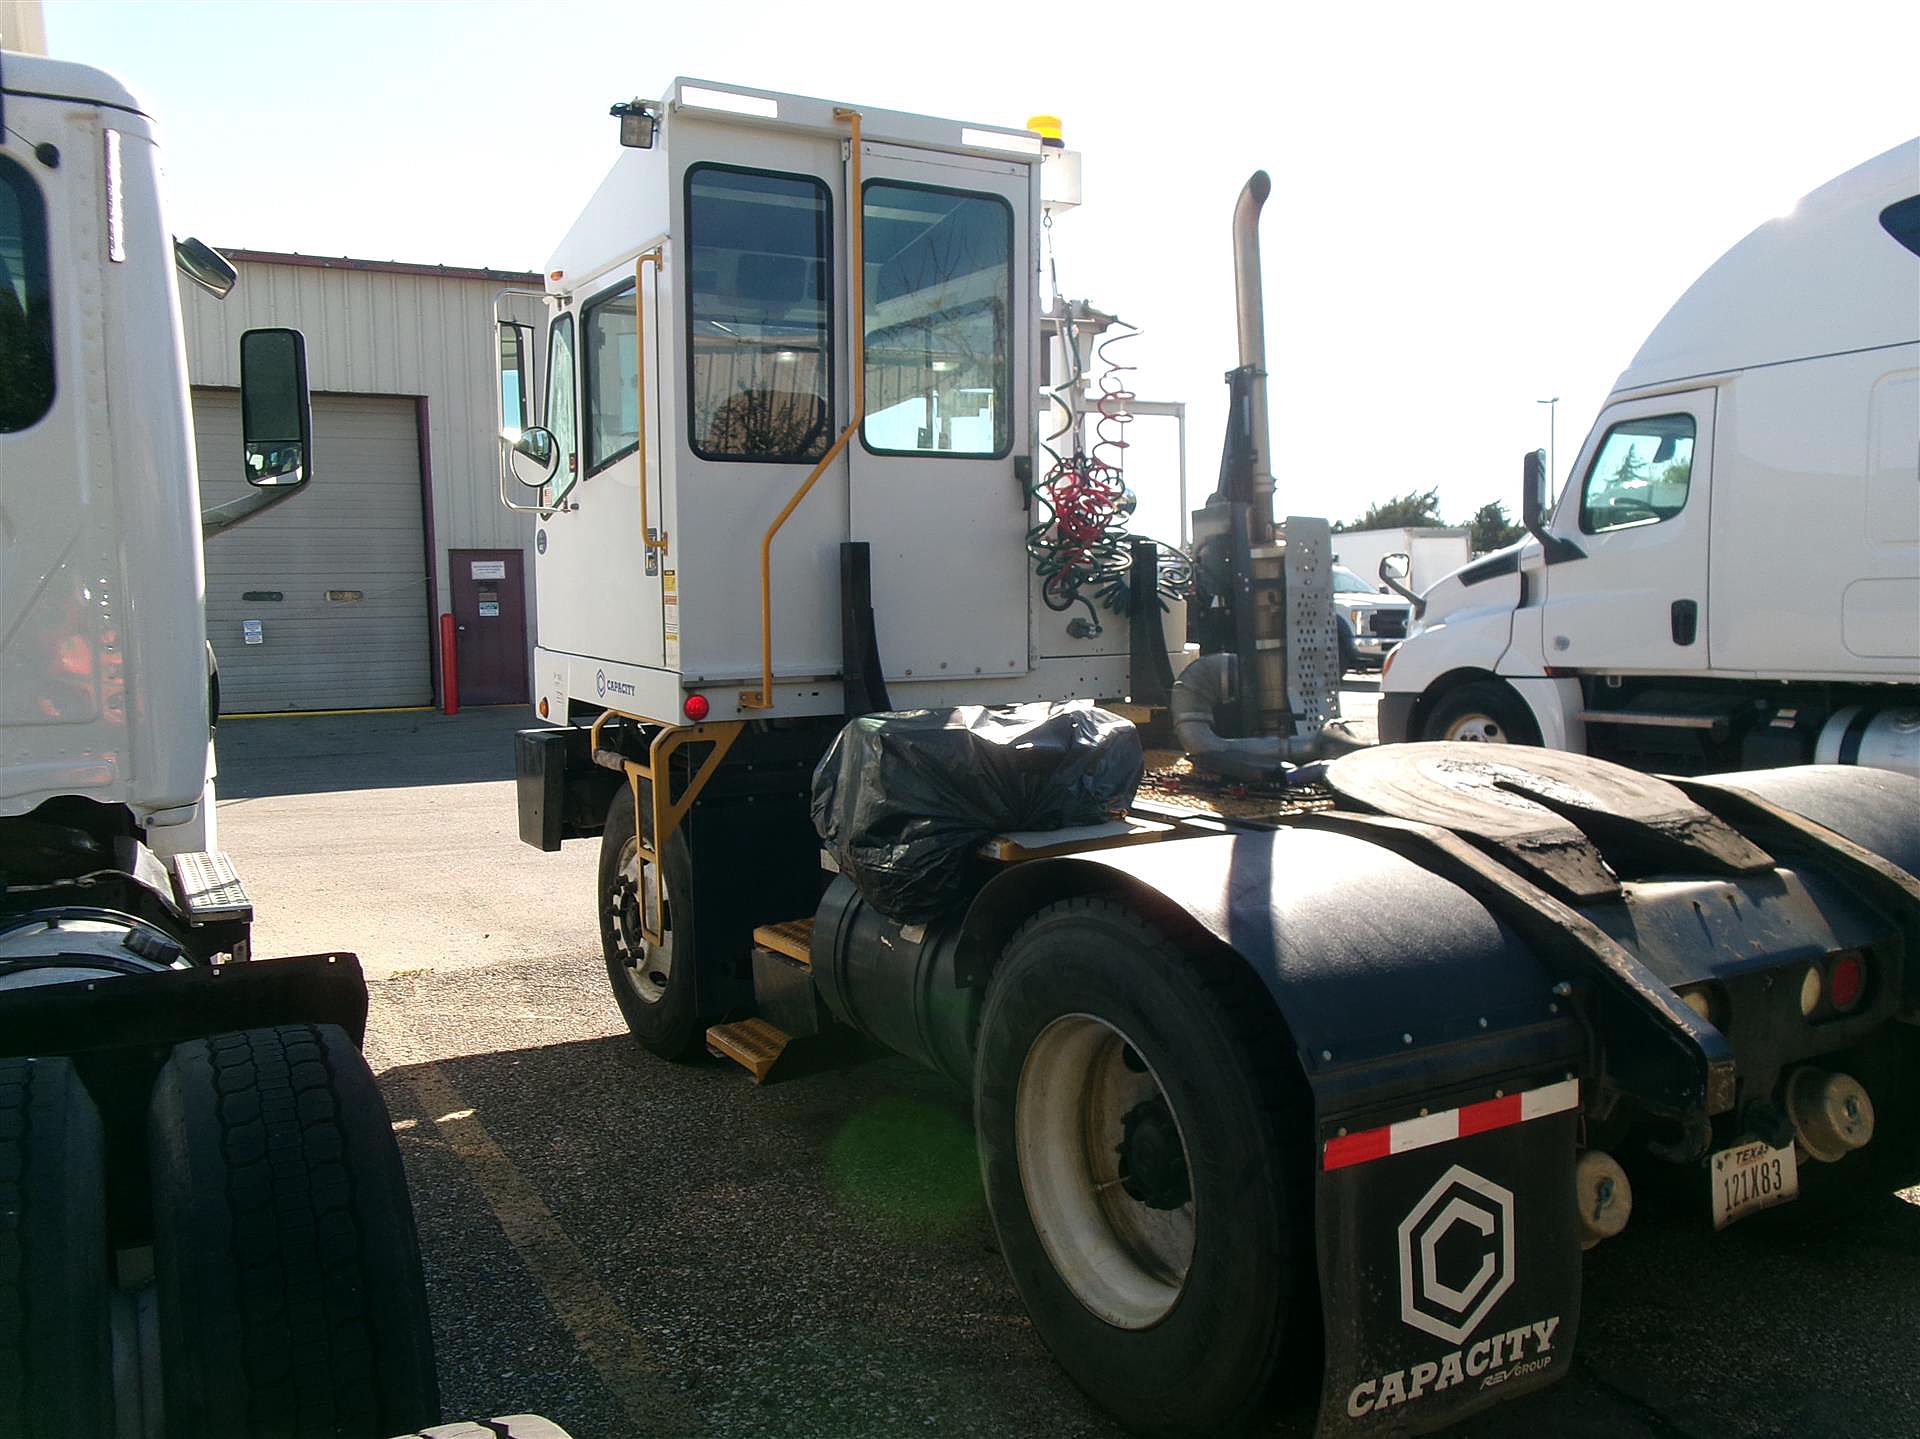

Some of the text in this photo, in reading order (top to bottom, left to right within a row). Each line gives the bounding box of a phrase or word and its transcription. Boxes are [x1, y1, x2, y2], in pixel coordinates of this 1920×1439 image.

[607, 680, 635, 697] CAPACITY
[1724, 1159, 1783, 1212] 121X83
[1347, 1316, 1560, 1418] CAPACITY
